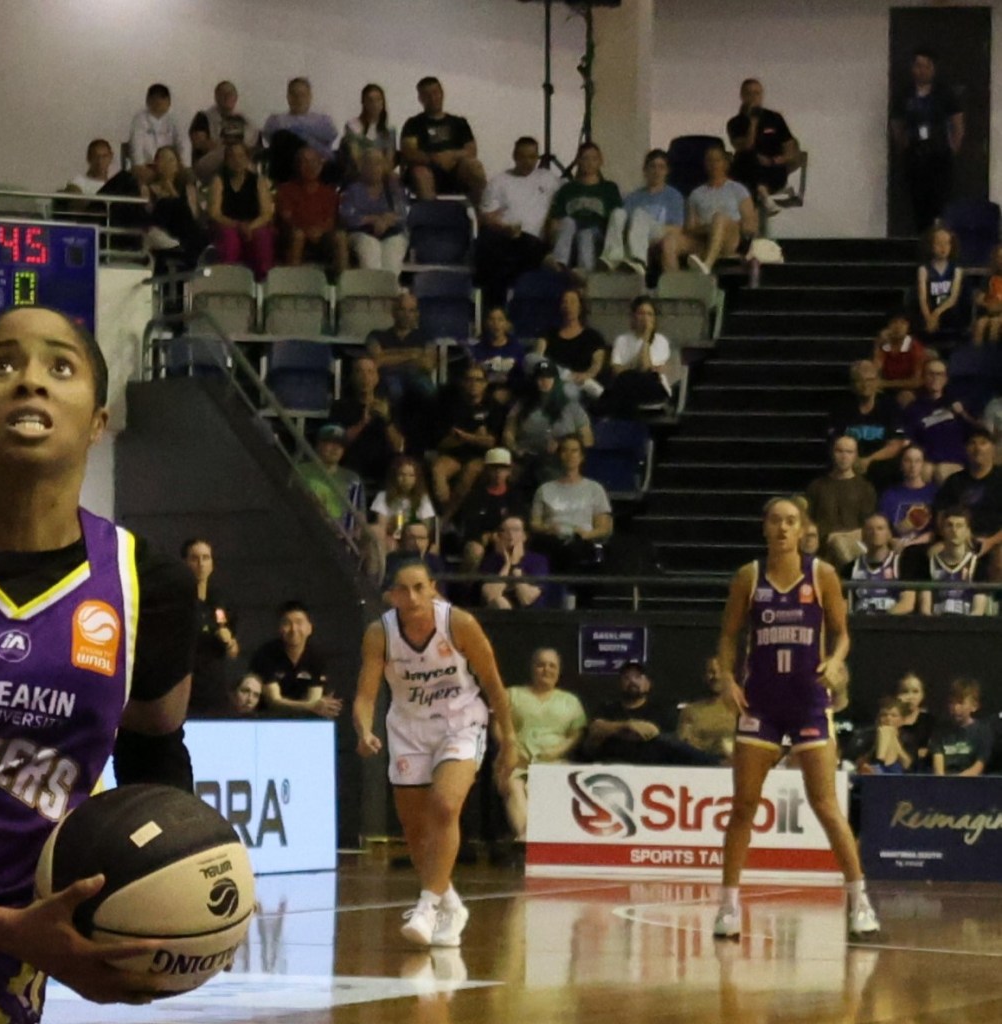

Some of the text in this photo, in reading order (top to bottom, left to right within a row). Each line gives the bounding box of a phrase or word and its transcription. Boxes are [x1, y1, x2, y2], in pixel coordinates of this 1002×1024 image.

[14, 271, 36, 305] 0
[630, 849, 726, 866] SPORTS TA
